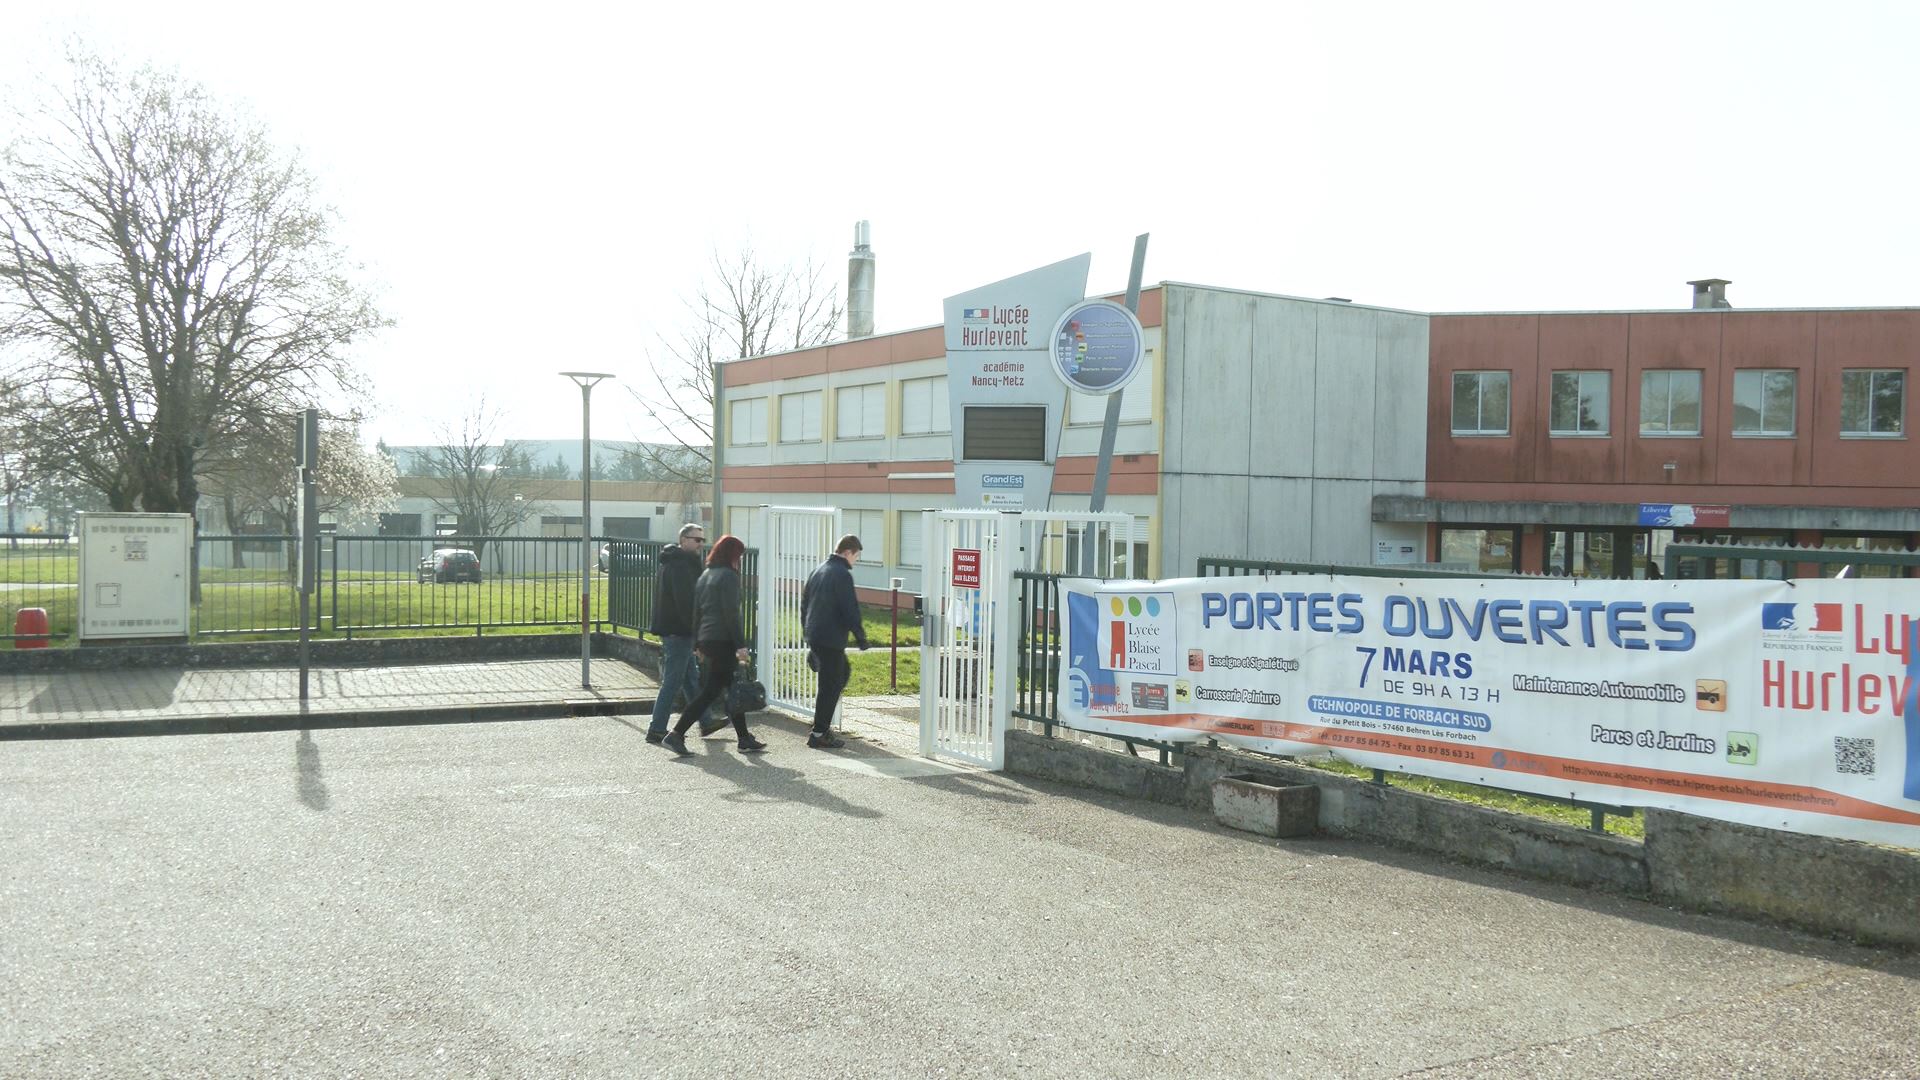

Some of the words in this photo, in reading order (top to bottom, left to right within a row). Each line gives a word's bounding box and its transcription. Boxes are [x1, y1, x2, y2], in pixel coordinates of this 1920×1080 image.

[993, 305, 1029, 328] Lycée
[962, 327, 1028, 346] Hurlevent
[983, 362, 1025, 372] académie
[972, 375, 1024, 388] Nancy-Metz
[1128, 622, 1161, 638] Lycée
[1201, 592, 1365, 634] PORTES
[1383, 595, 1697, 652] OUVERTES
[1854, 603, 1920, 665] Ly
[1128, 640, 1161, 655] Blaise
[1128, 657, 1161, 671] Pascal
[1208, 655, 1241, 669] Enseigne
[1242, 658, 1250, 668] et
[1250, 656, 1300, 673] Signalétique
[1356, 646, 1377, 688] 7
[1382, 646, 1473, 680] MARS
[1195, 685, 1241, 703] Carrosserie
[1241, 688, 1281, 706] Peinture
[1383, 679, 1405, 695] DE
[1412, 682, 1436, 697] 9H
[1440, 685, 1452, 700] A
[1460, 686, 1480, 702] 13
[1487, 688, 1500, 704] H
[1513, 674, 1599, 697] Maintenance
[1599, 680, 1686, 703] Automobile
[1762, 659, 1920, 717] Hurlev
[1319, 716, 1331, 724] Rue
[1332, 717, 1341, 725] du
[1343, 718, 1361, 729] Petit
[1361, 720, 1377, 730] Bois
[1382, 723, 1405, 733] 57460
[1406, 725, 1431, 737] Behren
[1445, 731, 1477, 741] Forbach
[1385, 704, 1401, 719] DE
[1403, 707, 1460, 726] FORBACH
[1462, 714, 1488, 729] SUD
[1332, 733, 1342, 743] 03
[1368, 738, 1379, 747] 84
[1380, 740, 1391, 749] 75
[1397, 742, 1411, 751] Fax
[1416, 744, 1426, 753] 03
[1428, 746, 1438, 754] 87
[1440, 748, 1450, 757] 85
[1452, 749, 1463, 758] 63
[1464, 751, 1475, 760] 31
[1591, 724, 1634, 745] Parcs
[1635, 730, 1654, 748] et
[1656, 731, 1716, 755] Jardins
